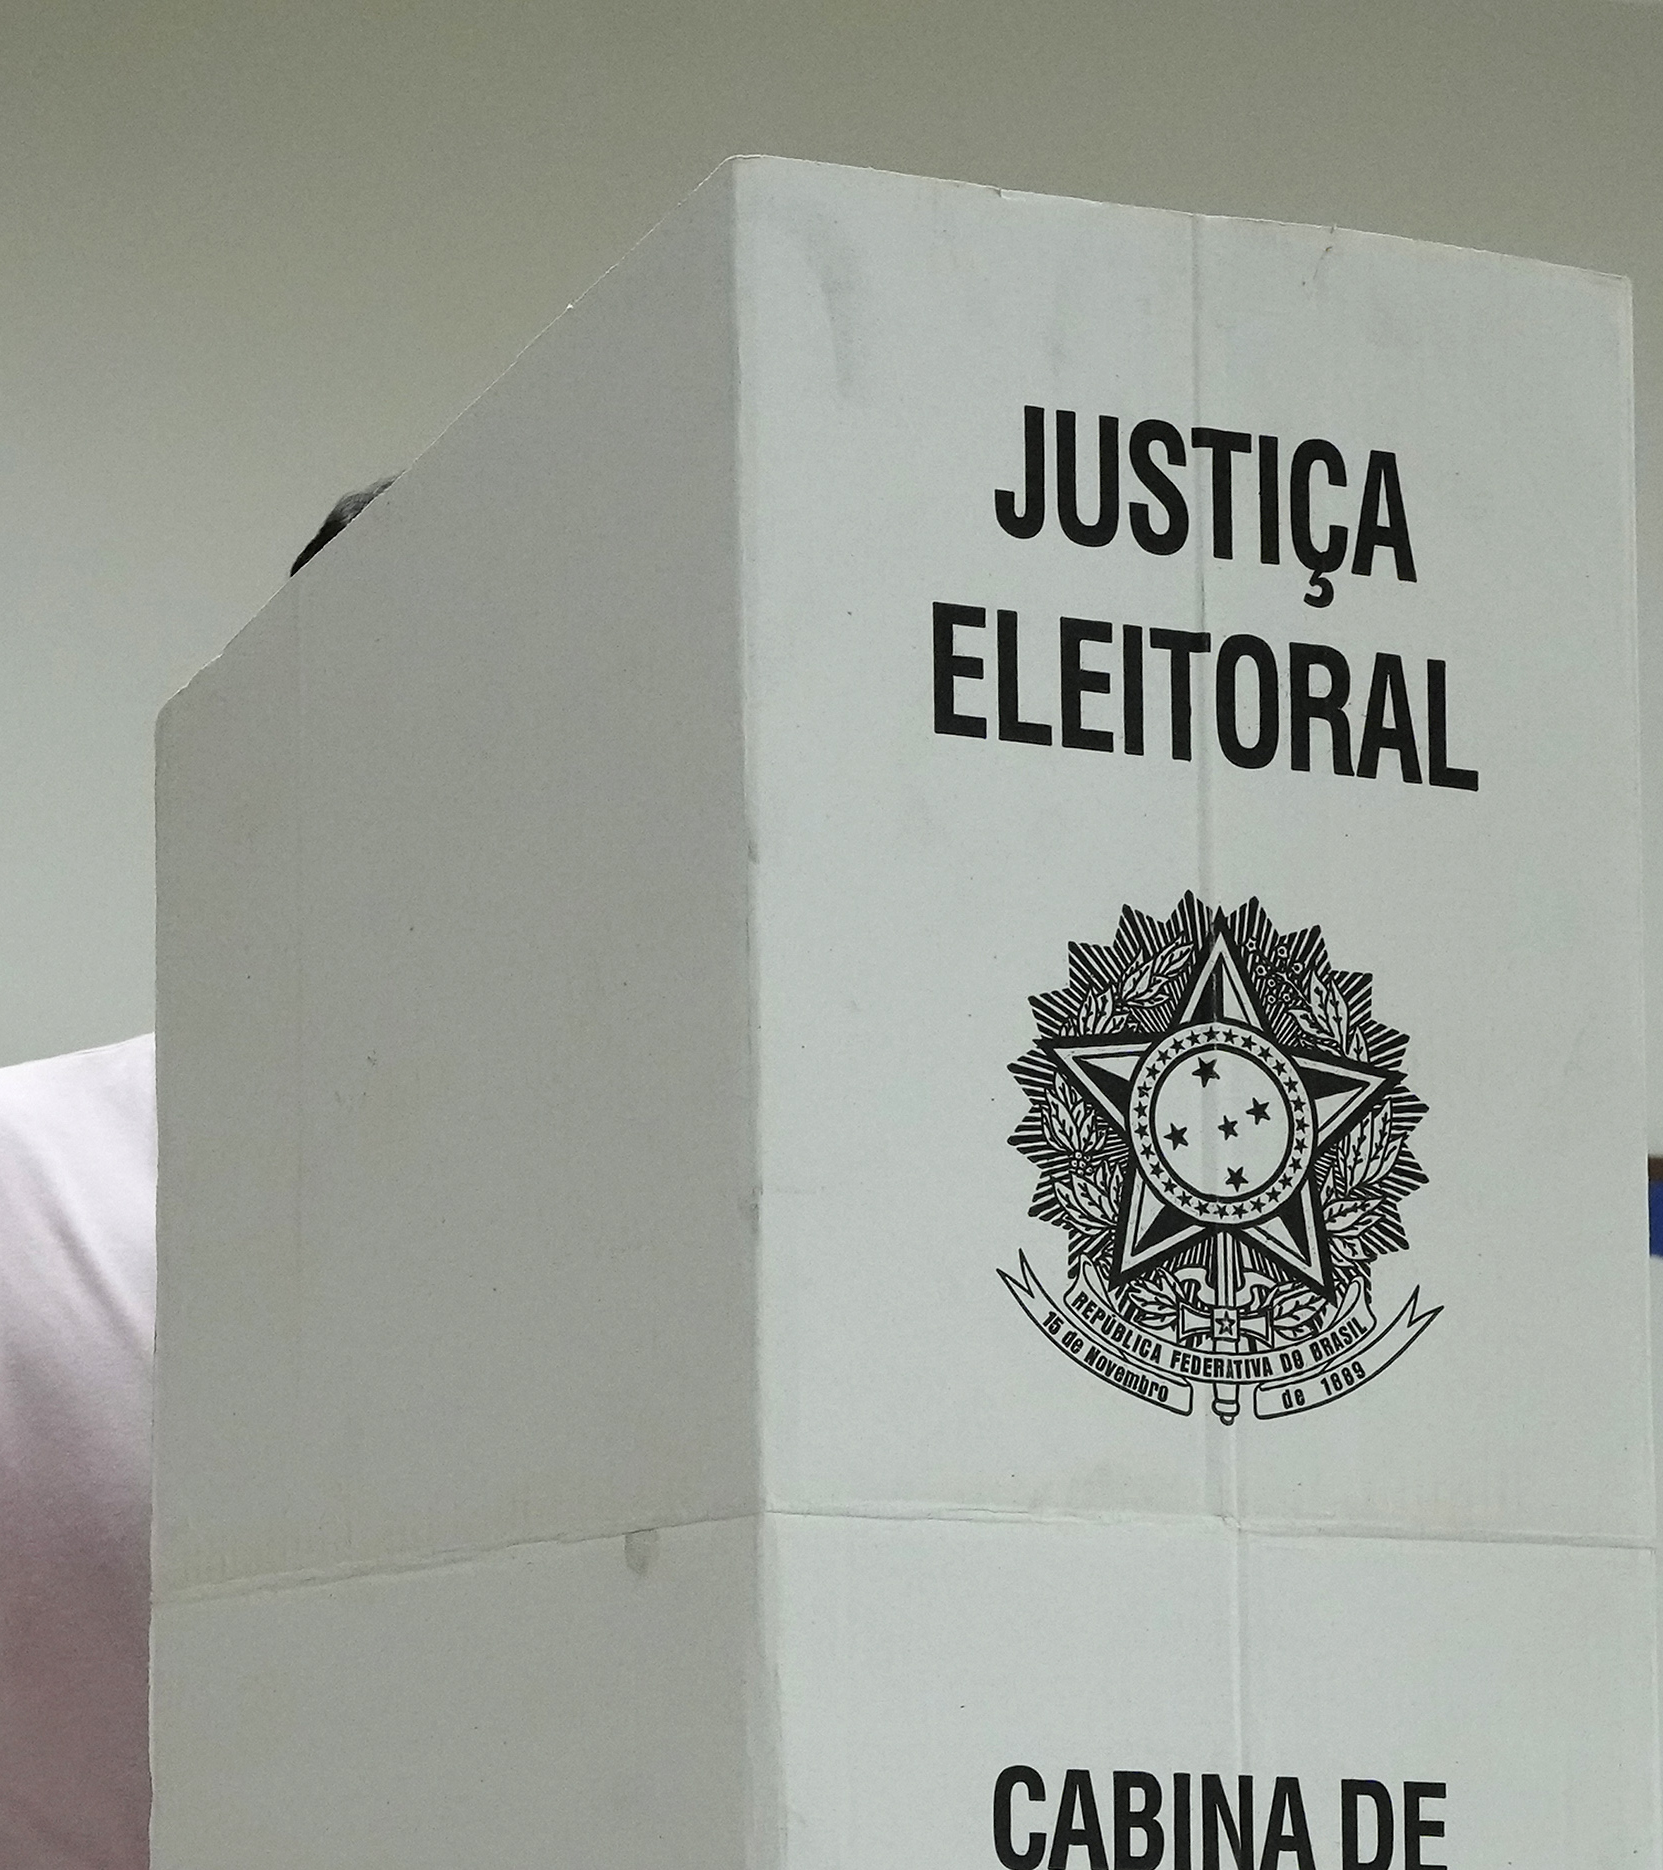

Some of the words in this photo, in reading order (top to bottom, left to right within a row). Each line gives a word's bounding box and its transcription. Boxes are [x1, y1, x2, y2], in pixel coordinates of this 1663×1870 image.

[994, 405, 1418, 608] JUSTIÇA
[932, 601, 1479, 792] ELEITORAL
[1042, 1310, 1062, 1335] 15
[1062, 1329, 1081, 1354] de
[1084, 1345, 1169, 1402] Novembro
[1072, 1293, 1161, 1363] REPÚBLICA
[1171, 1349, 1273, 1380] FEDERATIVA
[1279, 1350, 1304, 1371] DO
[1312, 1317, 1368, 1362] BRASIL
[1281, 1388, 1305, 1409] de
[1321, 1361, 1366, 1396] 1889
